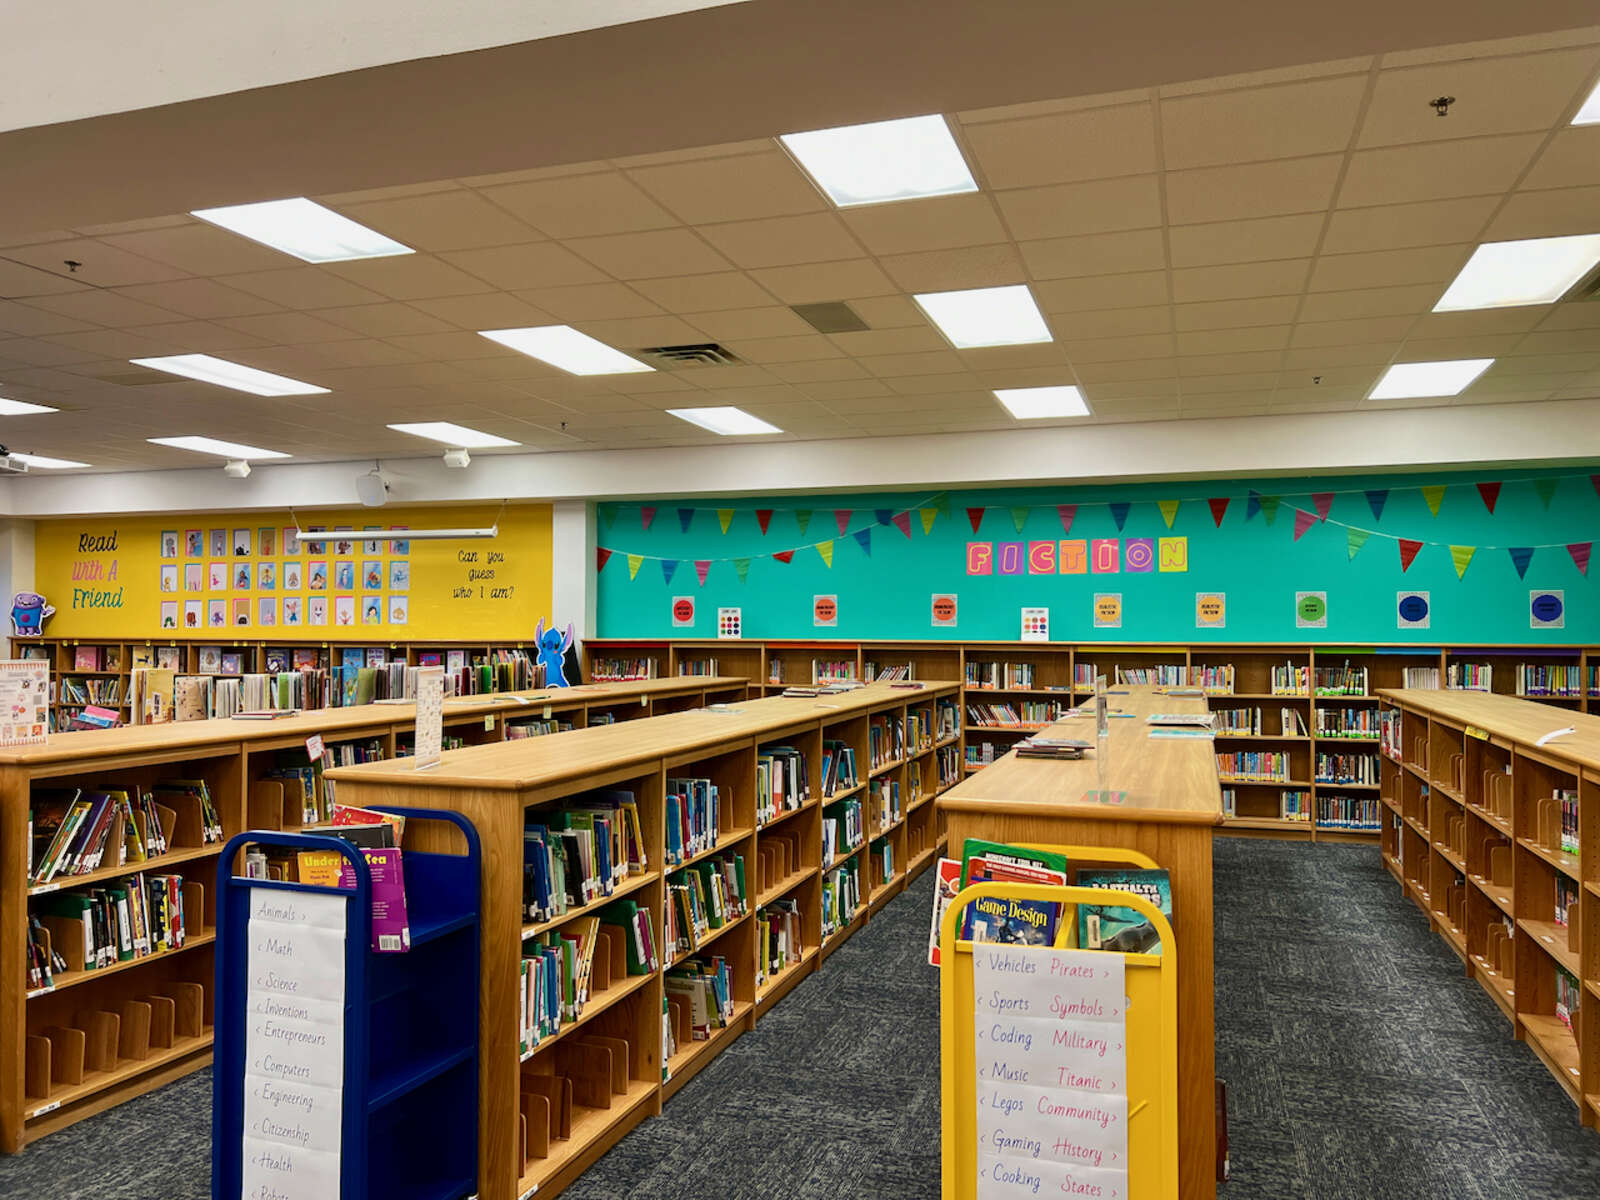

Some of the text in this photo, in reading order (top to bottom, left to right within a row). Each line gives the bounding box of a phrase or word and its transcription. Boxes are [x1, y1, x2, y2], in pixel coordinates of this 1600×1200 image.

[78, 530, 118, 553] Read
[458, 549, 504, 564] Can you
[968, 541, 1186, 573] FICTION
[72, 559, 118, 582] With A
[468, 568, 495, 582] guess
[72, 586, 124, 609] Friend
[453, 587, 473, 599] who
[490, 586, 515, 599] am?
[304, 855, 340, 867] Under
[364, 853, 387, 866] Sea
[257, 902, 295, 921] Animals
[975, 896, 1048, 929] Game Design
[265, 938, 293, 957] Math
[989, 952, 1036, 974] Vehicles
[1049, 957, 1095, 978] Pirates
[265, 971, 298, 993] Science
[264, 997, 309, 1020] Inventions
[988, 990, 1030, 1015] Sports
[1049, 994, 1104, 1020] Symbols
[264, 1020, 327, 1046] Entrepreneurs
[990, 1023, 1033, 1052] Coding
[1052, 1029, 1108, 1057] Military
[263, 1054, 311, 1079] Computers
[991, 1061, 1029, 1082] Music
[1057, 1066, 1103, 1089] Titanic
[261, 1082, 314, 1113] Engineering
[991, 1091, 1024, 1116] Legos
[1037, 1095, 1110, 1129] Community
[262, 1117, 310, 1147] Citizenship
[992, 1128, 1041, 1159] Gaming
[258, 1151, 293, 1174] Health
[1053, 1136, 1103, 1168] History
[992, 1162, 1041, 1194] Cooking
[1060, 1173, 1103, 1197] States
